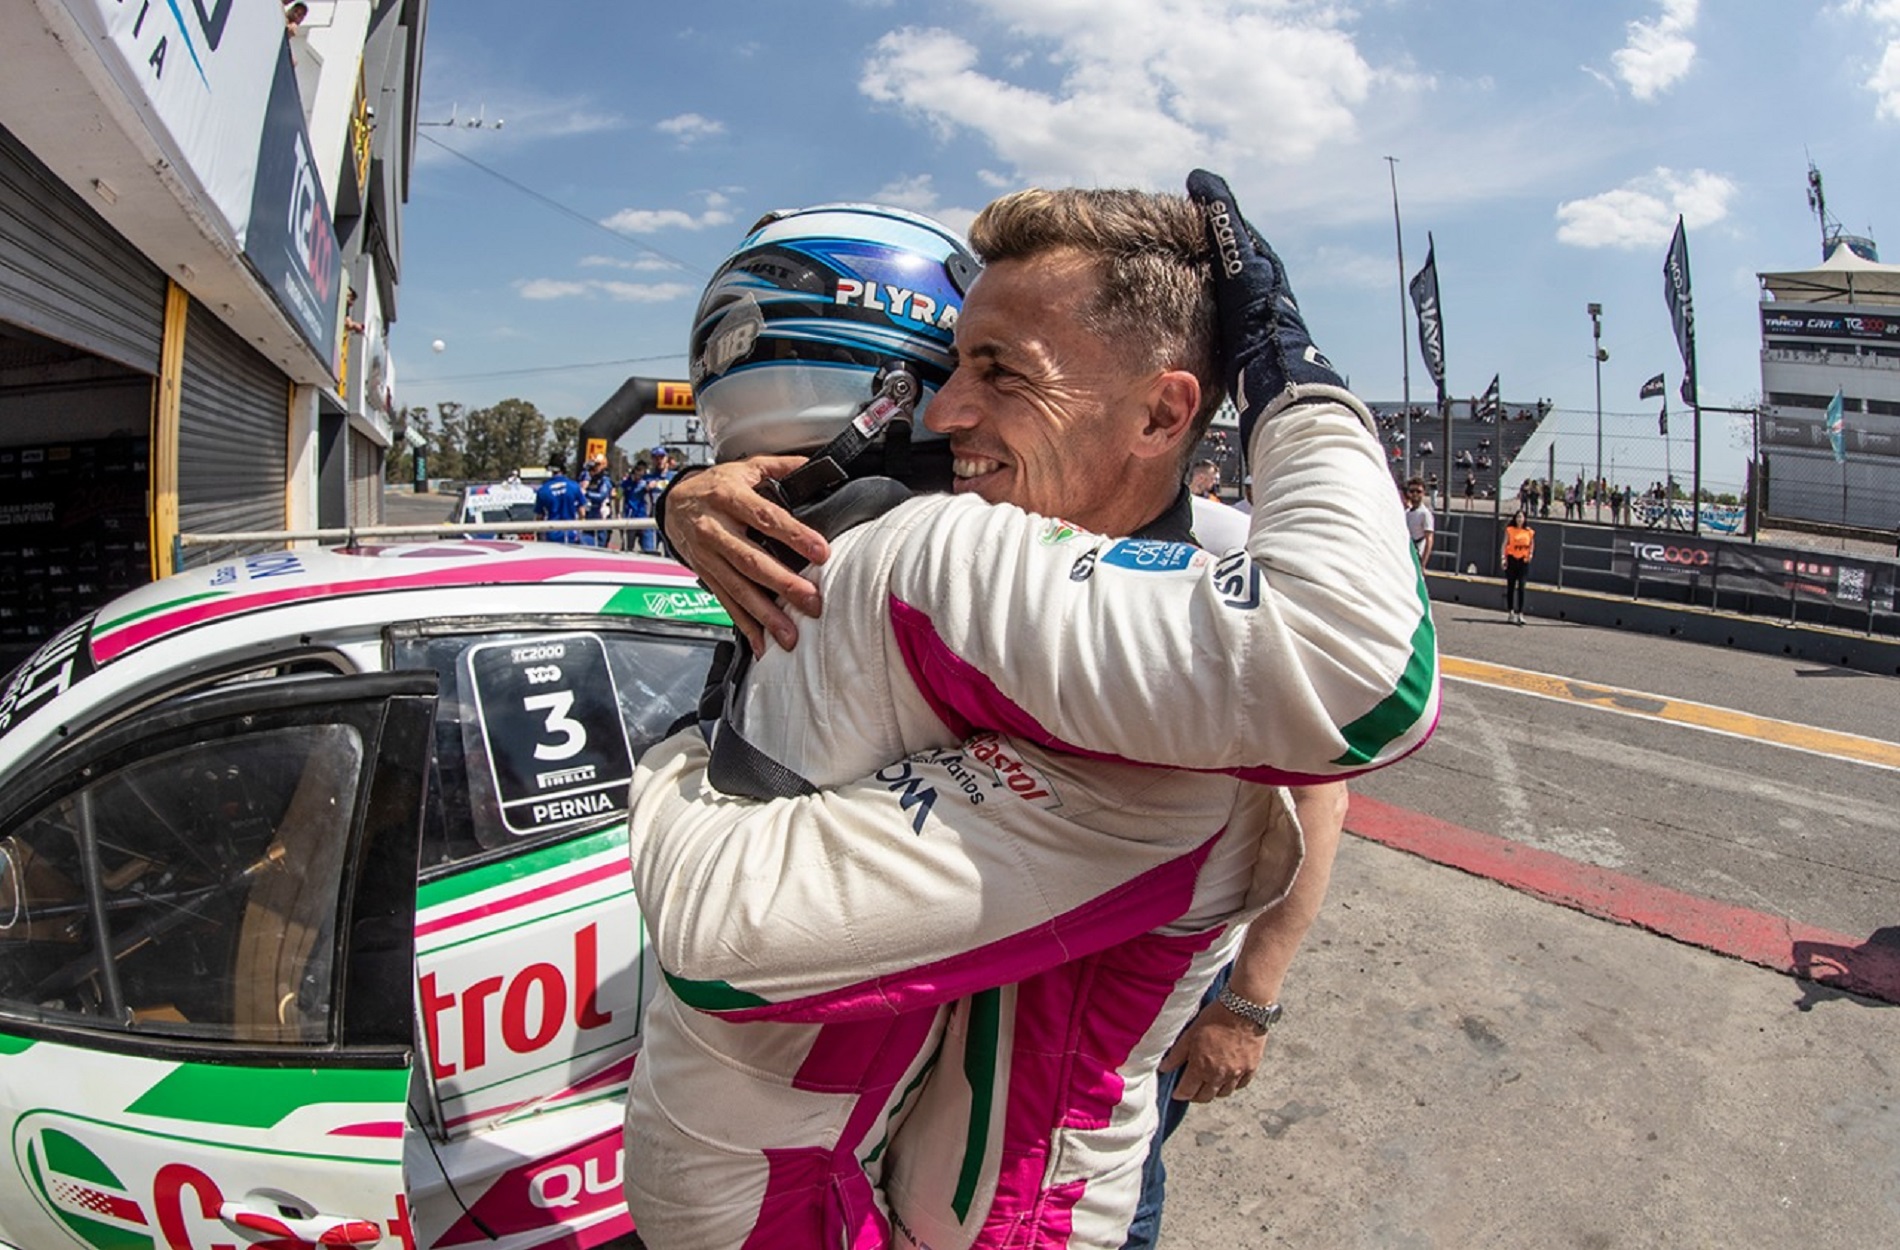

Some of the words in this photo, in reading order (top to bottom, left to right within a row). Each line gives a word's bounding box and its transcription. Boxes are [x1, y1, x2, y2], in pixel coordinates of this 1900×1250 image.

[287, 131, 332, 303] TC2000
[1210, 200, 1243, 276] sparco
[836, 278, 960, 331] PLYRA
[1630, 542, 1709, 565] TC2000
[511, 644, 565, 664] TC2000
[523, 690, 588, 761] 3
[536, 764, 596, 788] PIRELLI
[532, 792, 614, 823] PERNIA
[419, 921, 613, 1080] trol
